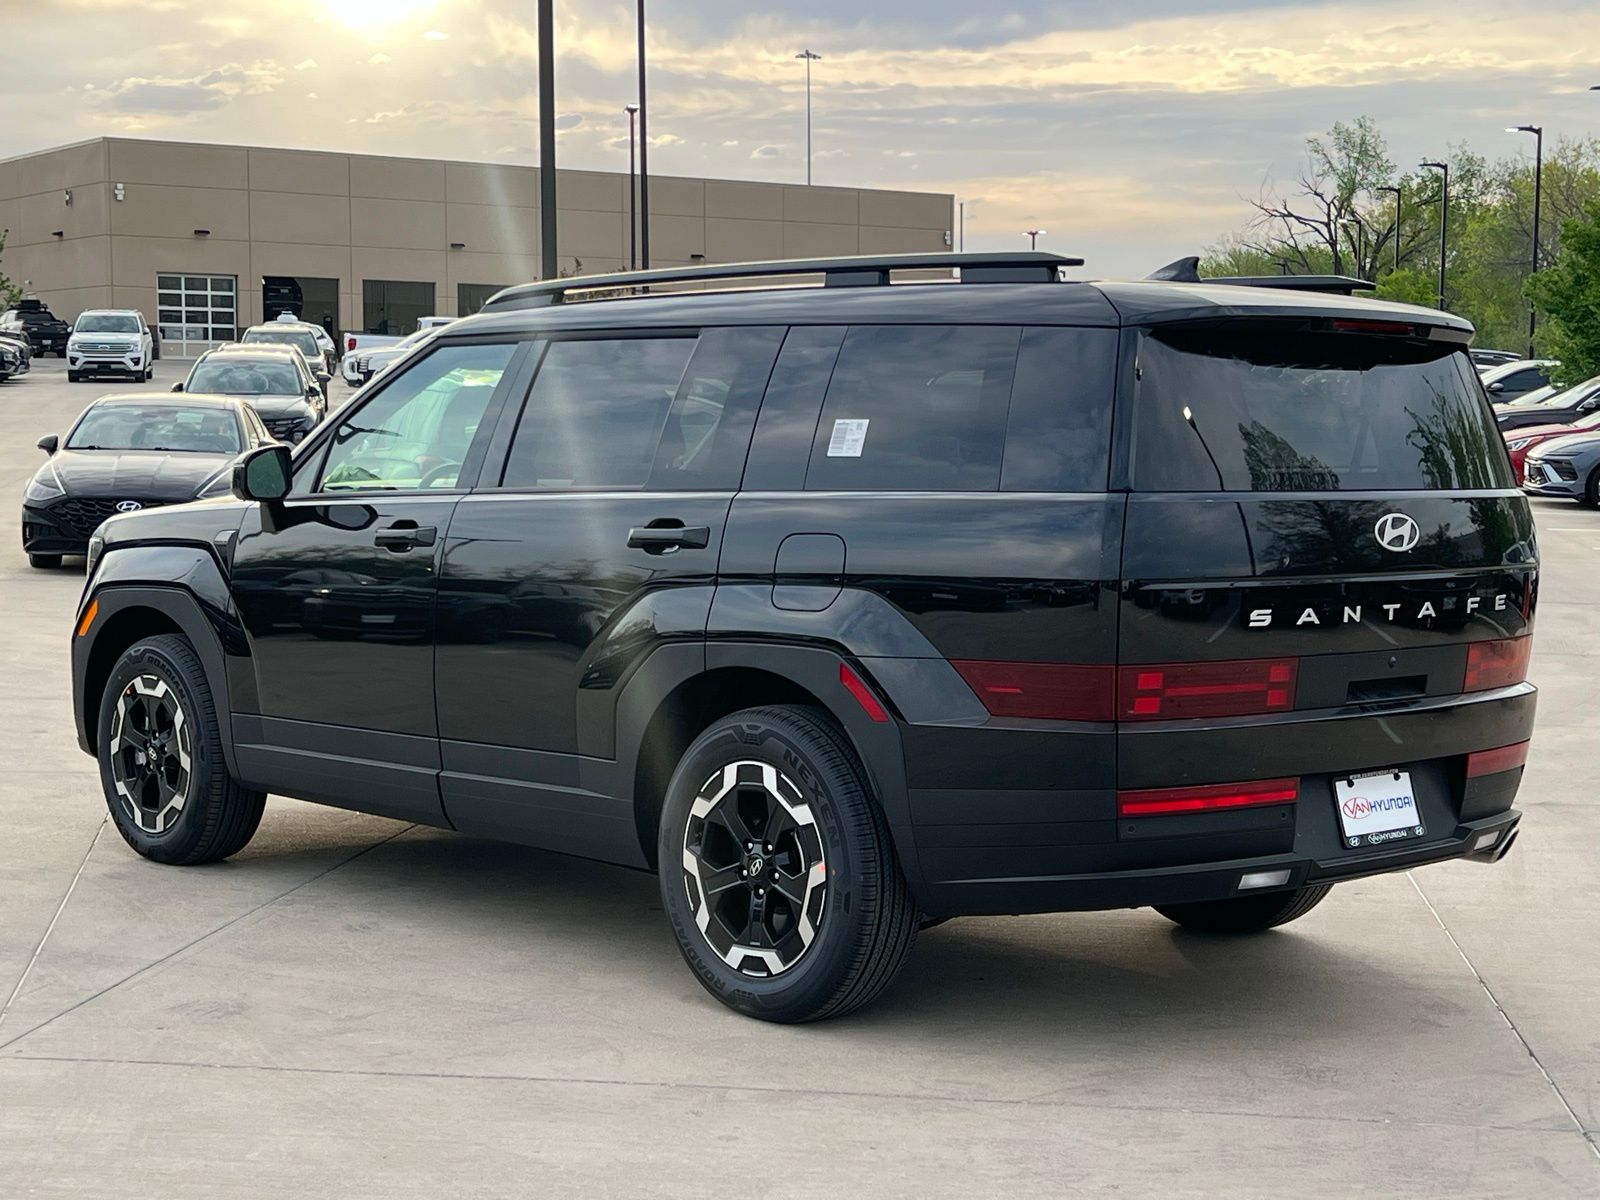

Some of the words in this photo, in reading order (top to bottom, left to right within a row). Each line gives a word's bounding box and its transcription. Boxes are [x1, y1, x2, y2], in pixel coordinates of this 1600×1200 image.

[1249, 601, 1436, 627] SANTA
[1467, 593, 1507, 614] FE
[784, 748, 840, 848] NEXEN
